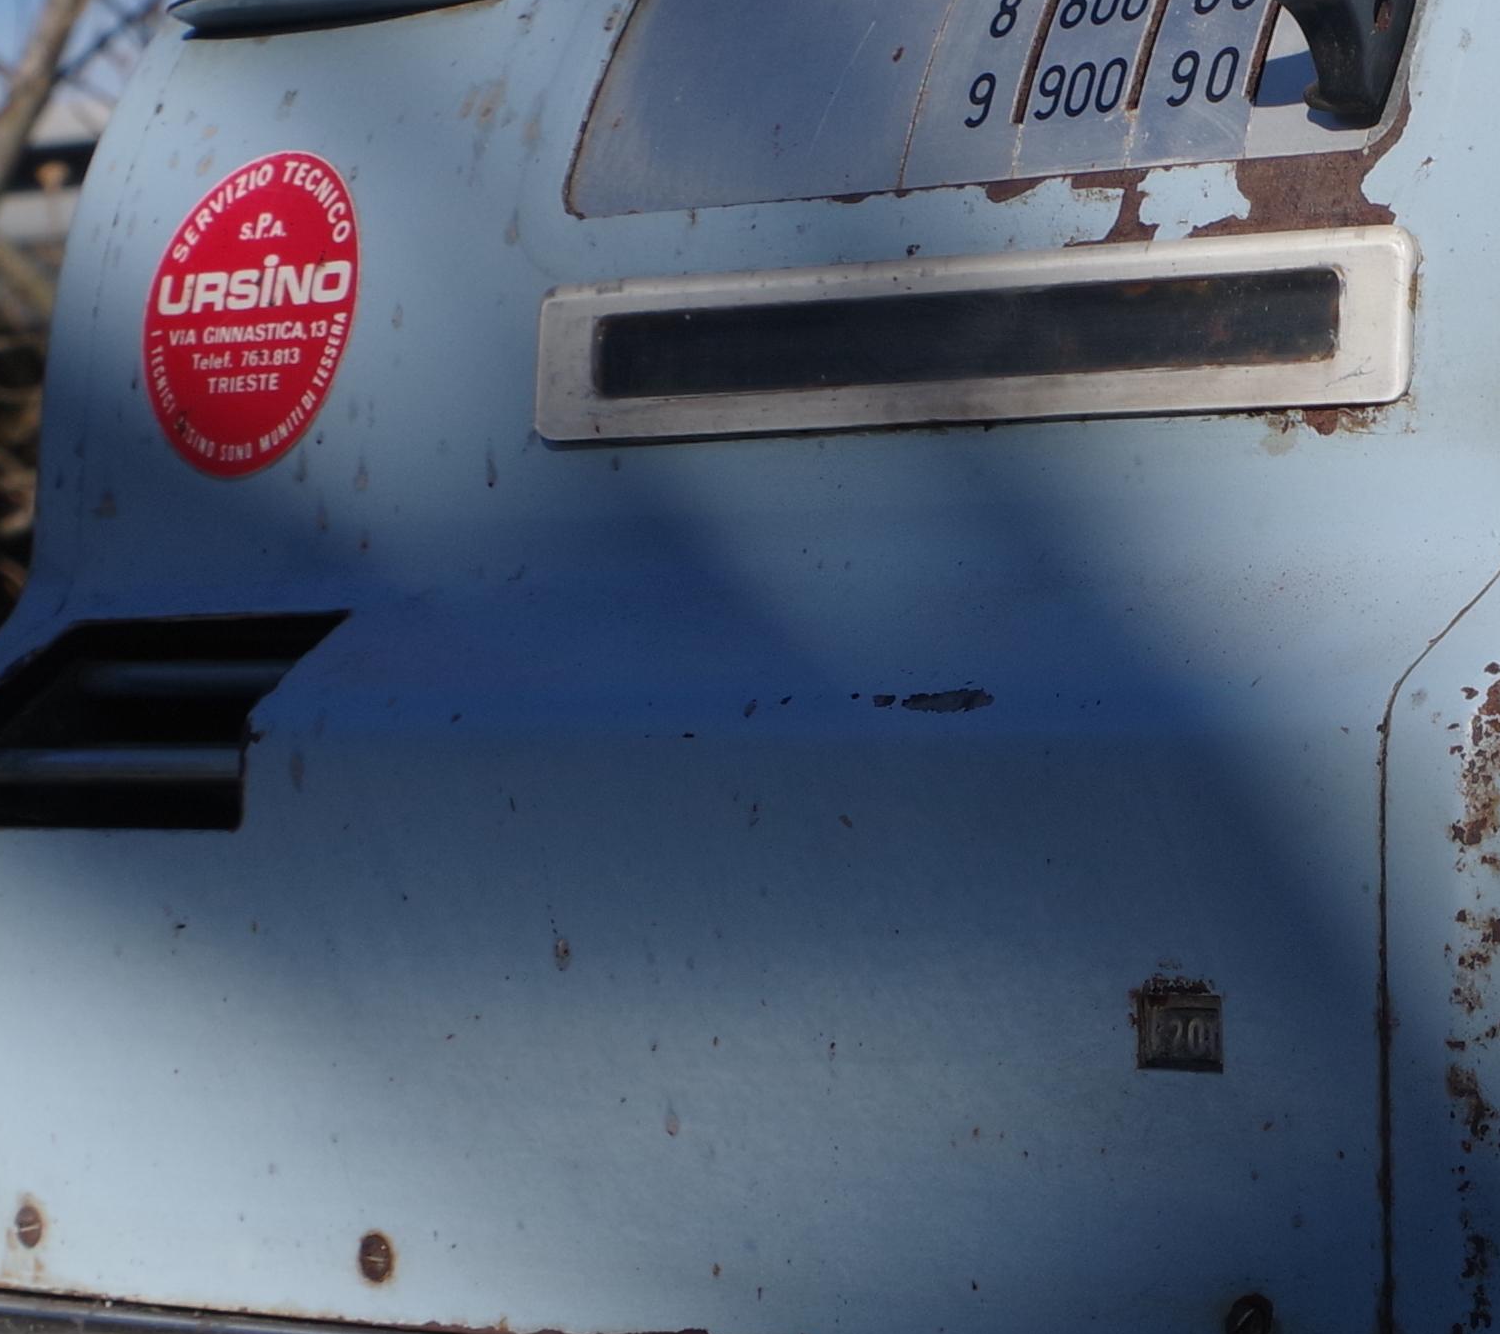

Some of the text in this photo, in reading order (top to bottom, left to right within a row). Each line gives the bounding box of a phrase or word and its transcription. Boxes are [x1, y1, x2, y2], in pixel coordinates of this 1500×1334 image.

[964, 47, 1239, 127] 9 900 90
[172, 161, 350, 263] SERVIZIO TECNICO
[202, 321, 307, 344] GINNASTICA,
[310, 320, 328, 338] 13
[192, 347, 300, 370] Telef. 763.813
[207, 373, 280, 394] TRIESTE
[150, 345, 176, 414] TECNICI
[219, 442, 253, 461] SONO
[259, 406, 304, 453] MUNITI
[300, 389, 317, 411] DI
[312, 312, 348, 388] TESSERA
